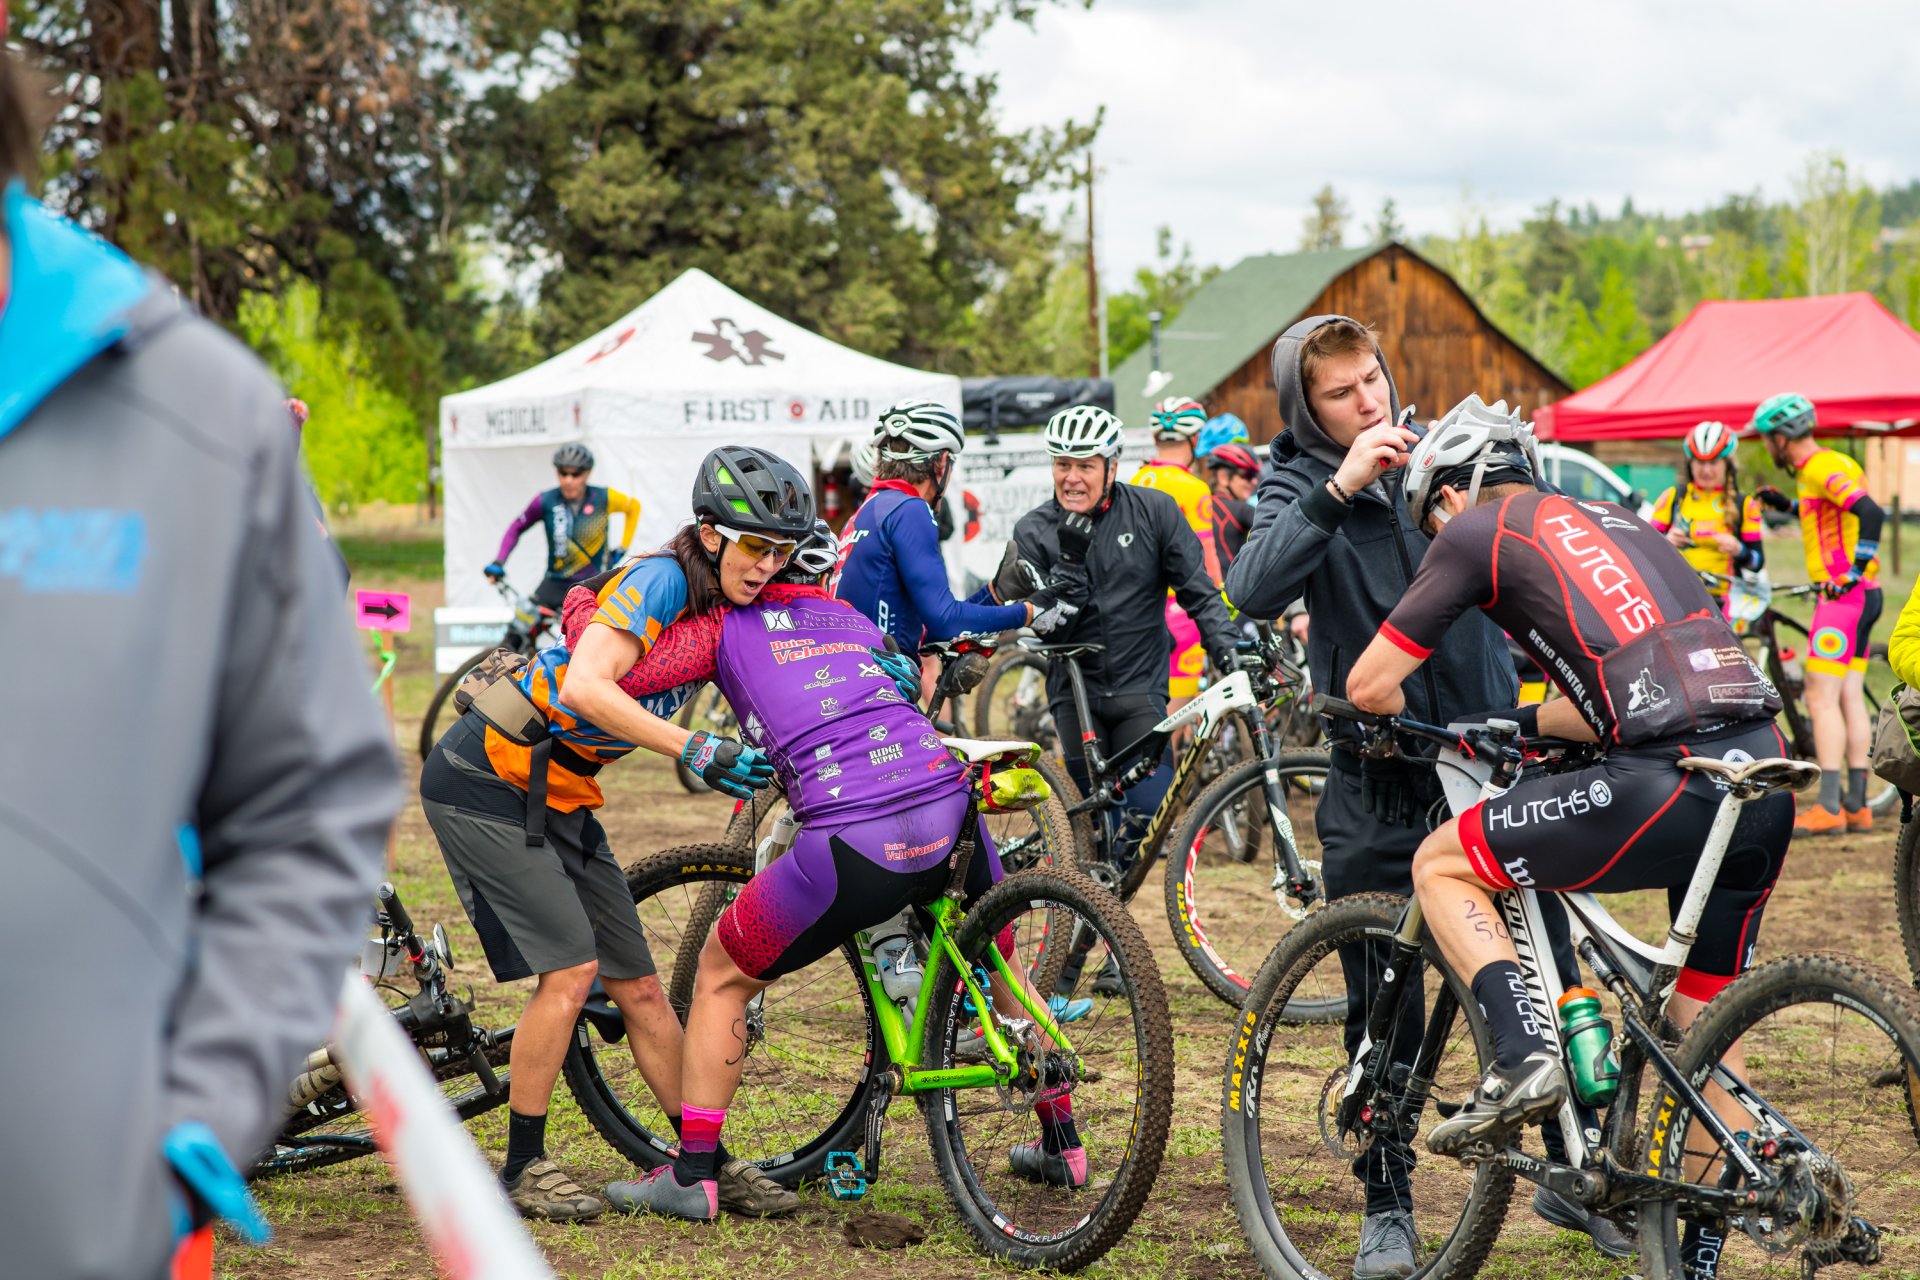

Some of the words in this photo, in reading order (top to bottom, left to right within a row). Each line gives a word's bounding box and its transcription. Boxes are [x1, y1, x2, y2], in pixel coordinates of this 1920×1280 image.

[485, 404, 548, 440] MEDICAL
[684, 399, 774, 424] FIRST
[819, 398, 870, 421] AID
[794, 619, 836, 629] HEALTH
[803, 611, 859, 624] DIGESTIVE
[769, 638, 816, 652] Boise
[1528, 628, 1556, 660] BEND
[1555, 656, 1586, 702] DENTAL
[868, 742, 903, 760] RIDGE
[871, 750, 904, 766] SUPPLY
[1489, 788, 1591, 831] HUTCH'S
[884, 843, 906, 851] Boise
[885, 835, 950, 861] VeloWomen
[682, 864, 753, 876] MAXXI
[1176, 881, 1201, 948] MAXXIS
[1464, 899, 1491, 919] 2
[858, 976, 870, 1010] FLAG
[945, 993, 960, 1039] BLACK
[866, 1012, 874, 1051] BLACK
[1229, 1011, 1257, 1112] MAXXIS
[1647, 1095, 1676, 1178] AXXI
[1013, 1229, 1041, 1242] BLACK
[1042, 1231, 1063, 1242] FLAG
